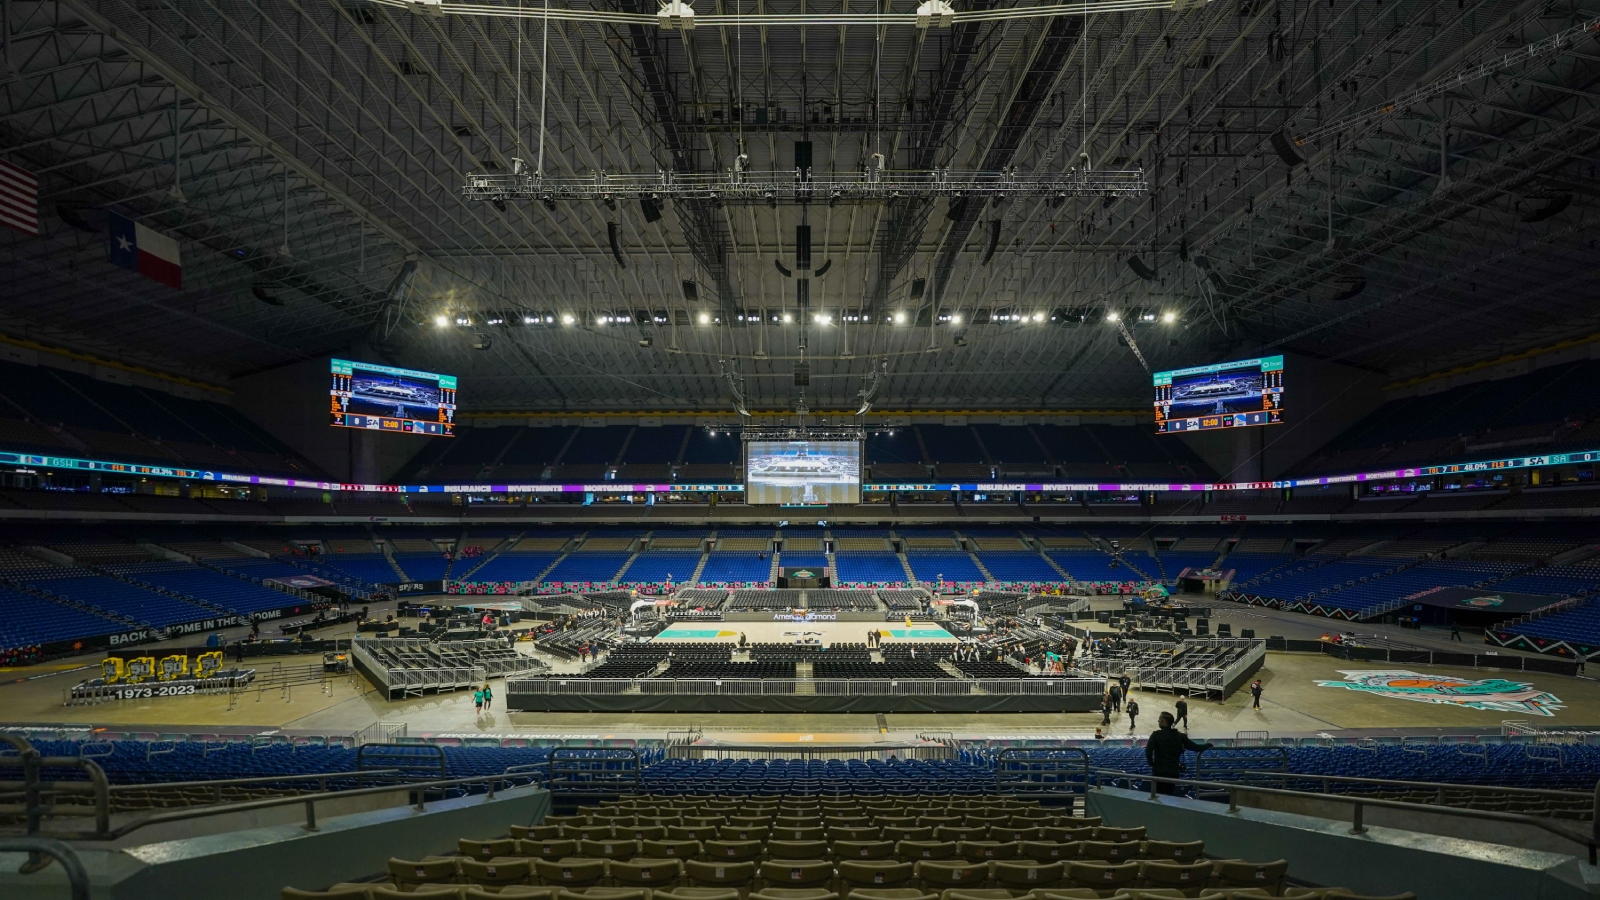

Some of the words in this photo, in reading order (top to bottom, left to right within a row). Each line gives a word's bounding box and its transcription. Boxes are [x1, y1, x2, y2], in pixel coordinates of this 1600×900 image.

[110, 630, 147, 645] BACK
[204, 620, 214, 629] IN
[217, 616, 237, 627] THE
[130, 663, 150, 674] 50
[164, 662, 182, 673] 50
[116, 685, 195, 699] 1973-2023
